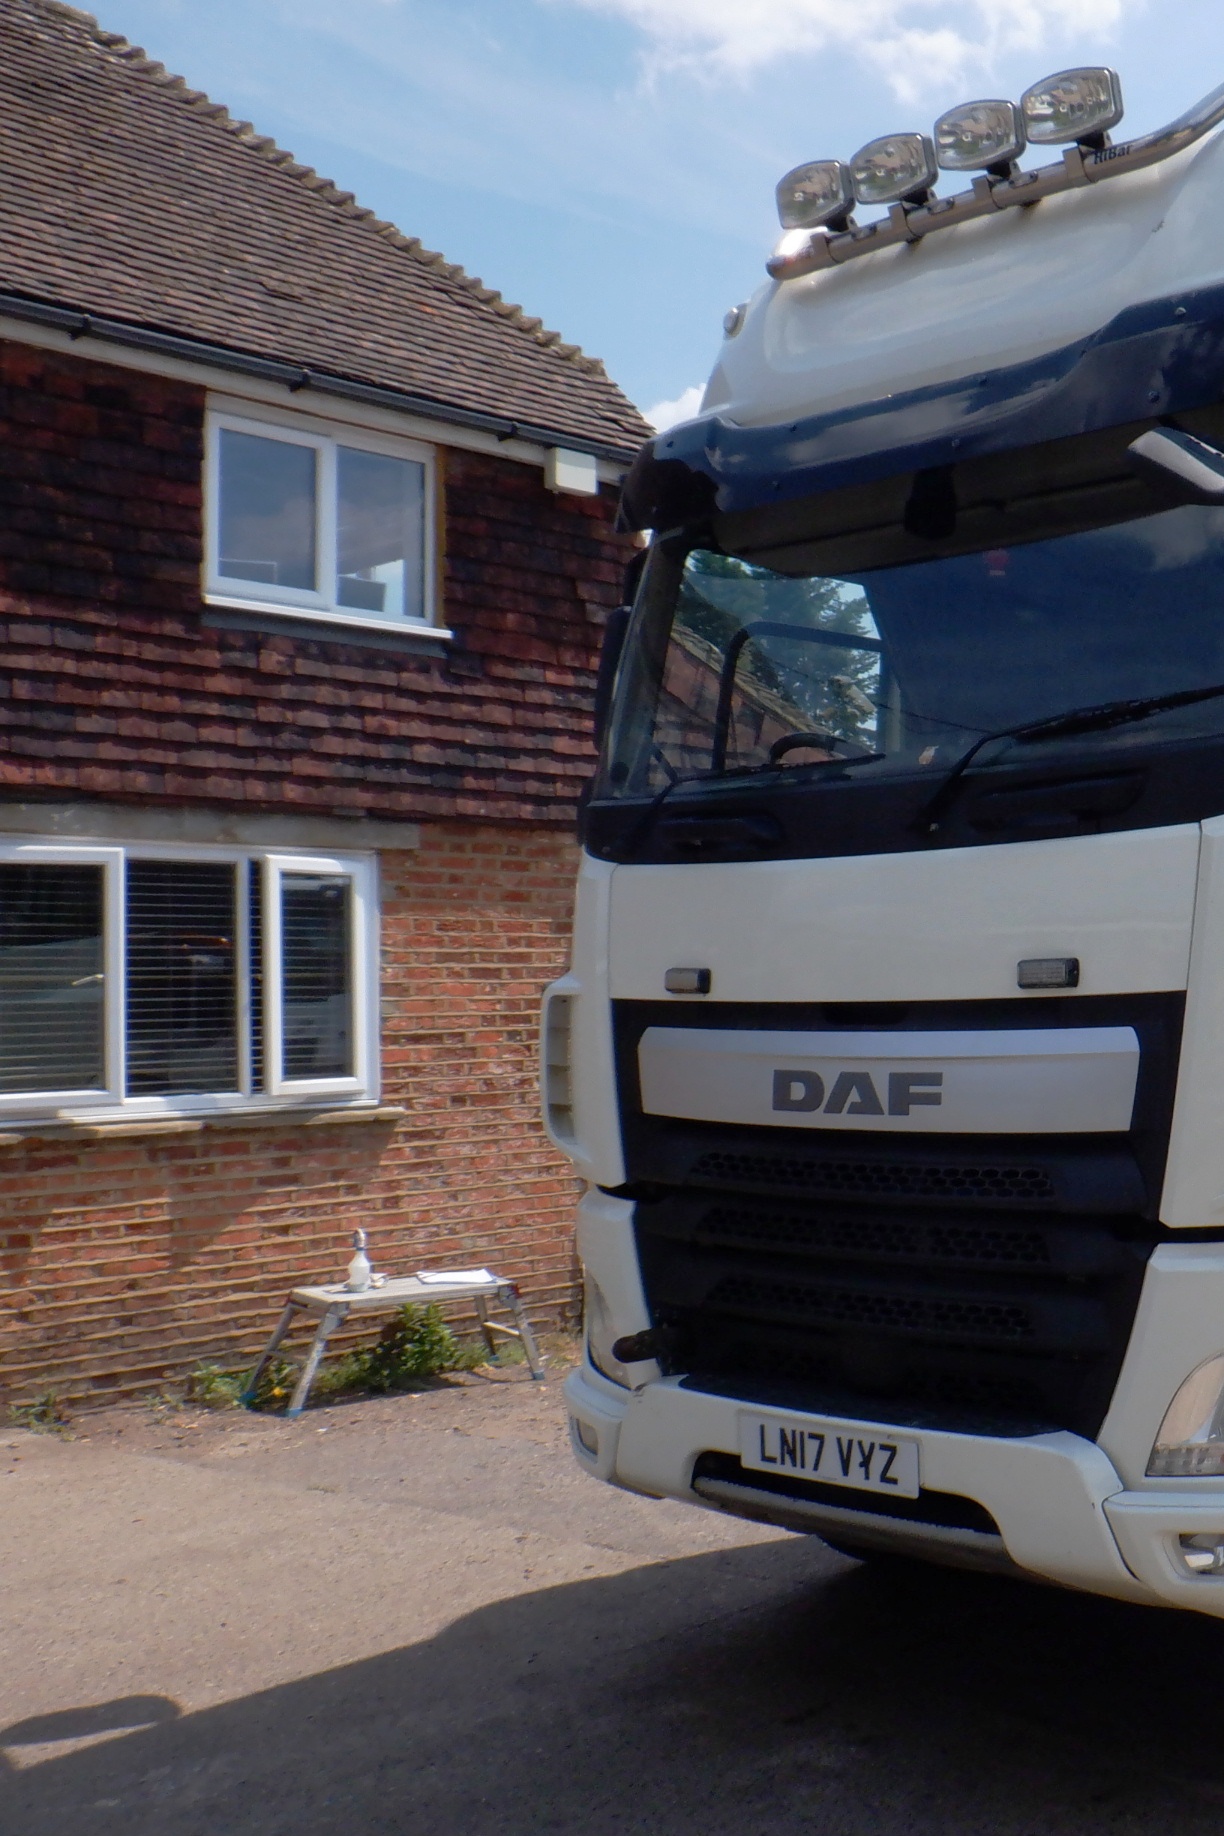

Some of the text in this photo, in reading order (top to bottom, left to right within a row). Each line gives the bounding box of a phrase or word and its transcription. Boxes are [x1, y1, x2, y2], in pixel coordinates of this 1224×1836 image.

[772, 1069, 943, 1116] DAF
[760, 1423, 899, 1486] LN17 VYZ
